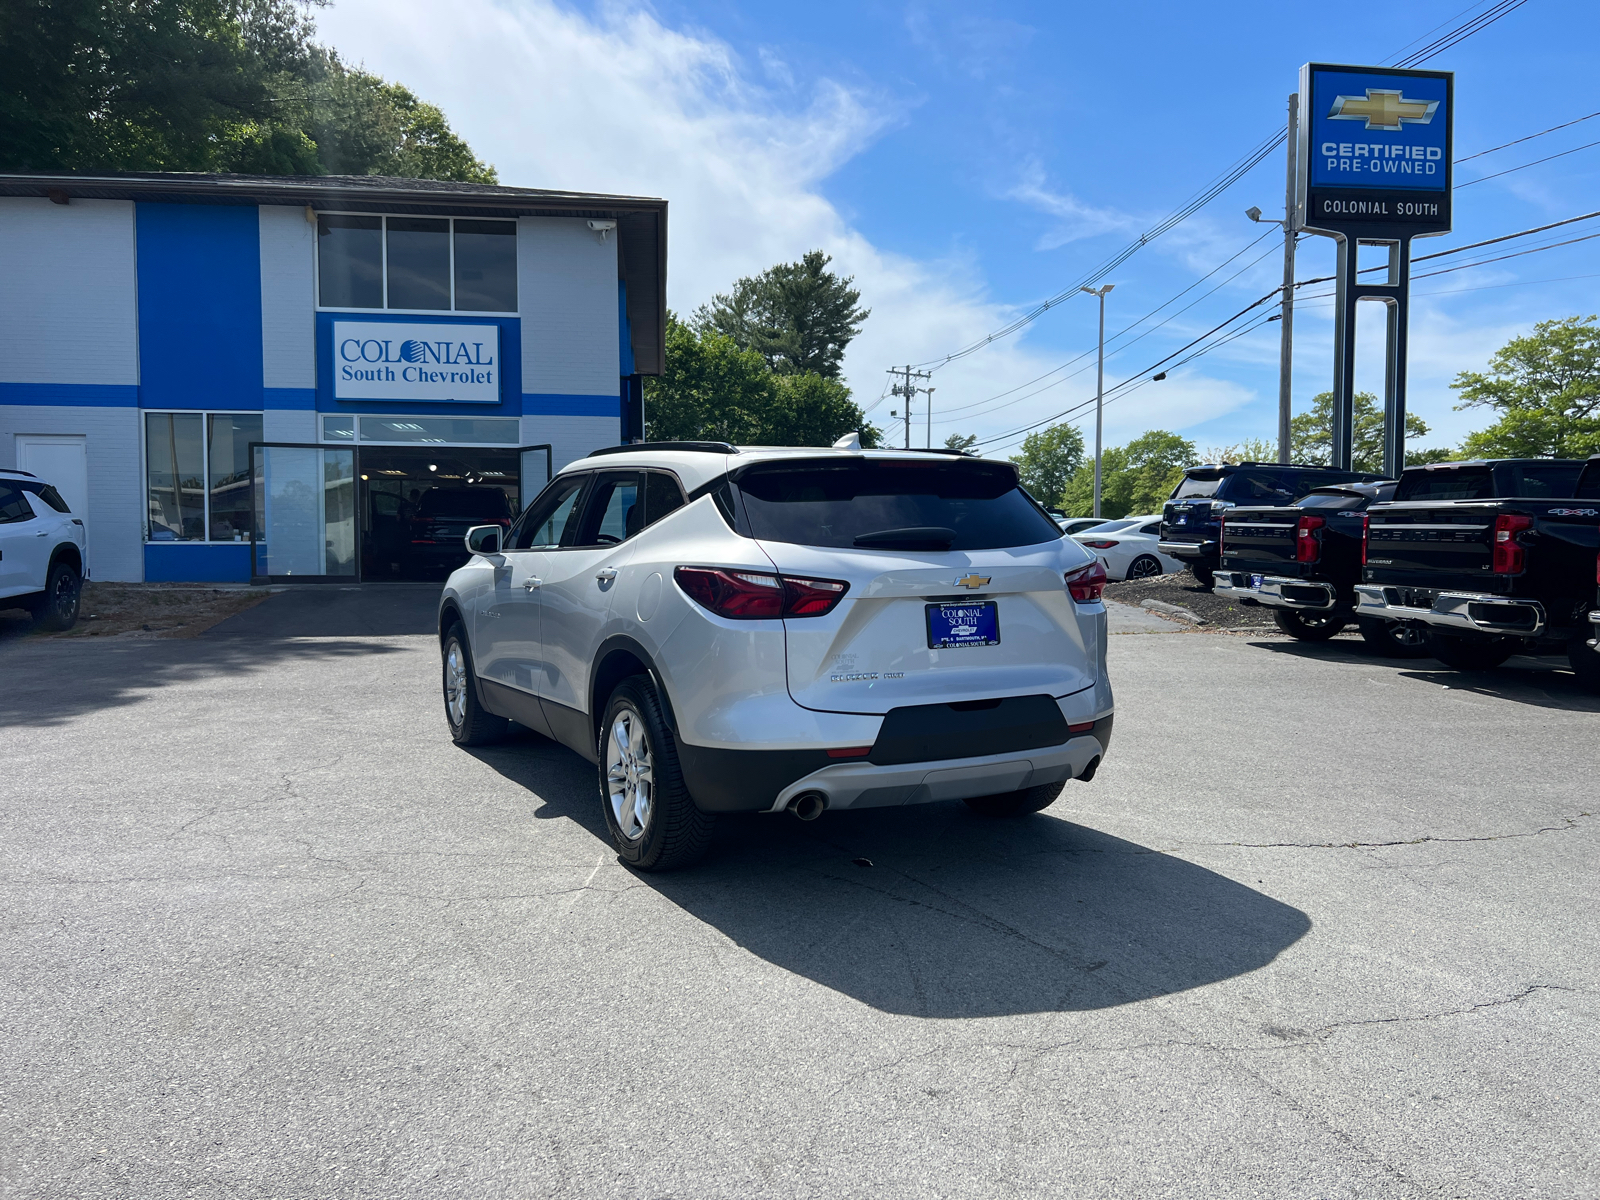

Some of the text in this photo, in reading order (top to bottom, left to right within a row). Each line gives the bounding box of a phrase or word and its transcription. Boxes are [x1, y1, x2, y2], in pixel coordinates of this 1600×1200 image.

[1321, 142, 1442, 160] CERTIFIED
[1327, 158, 1436, 175] PRE-OWNED
[1323, 200, 1438, 216] COLONIAL SOUTH
[340, 338, 493, 366] COLONIAL
[341, 365, 493, 384] South Chevrolet
[1371, 531, 1481, 542] CHEVROLET
[941, 609, 983, 619] COLONIAL
[948, 617, 977, 626] SOUTH
